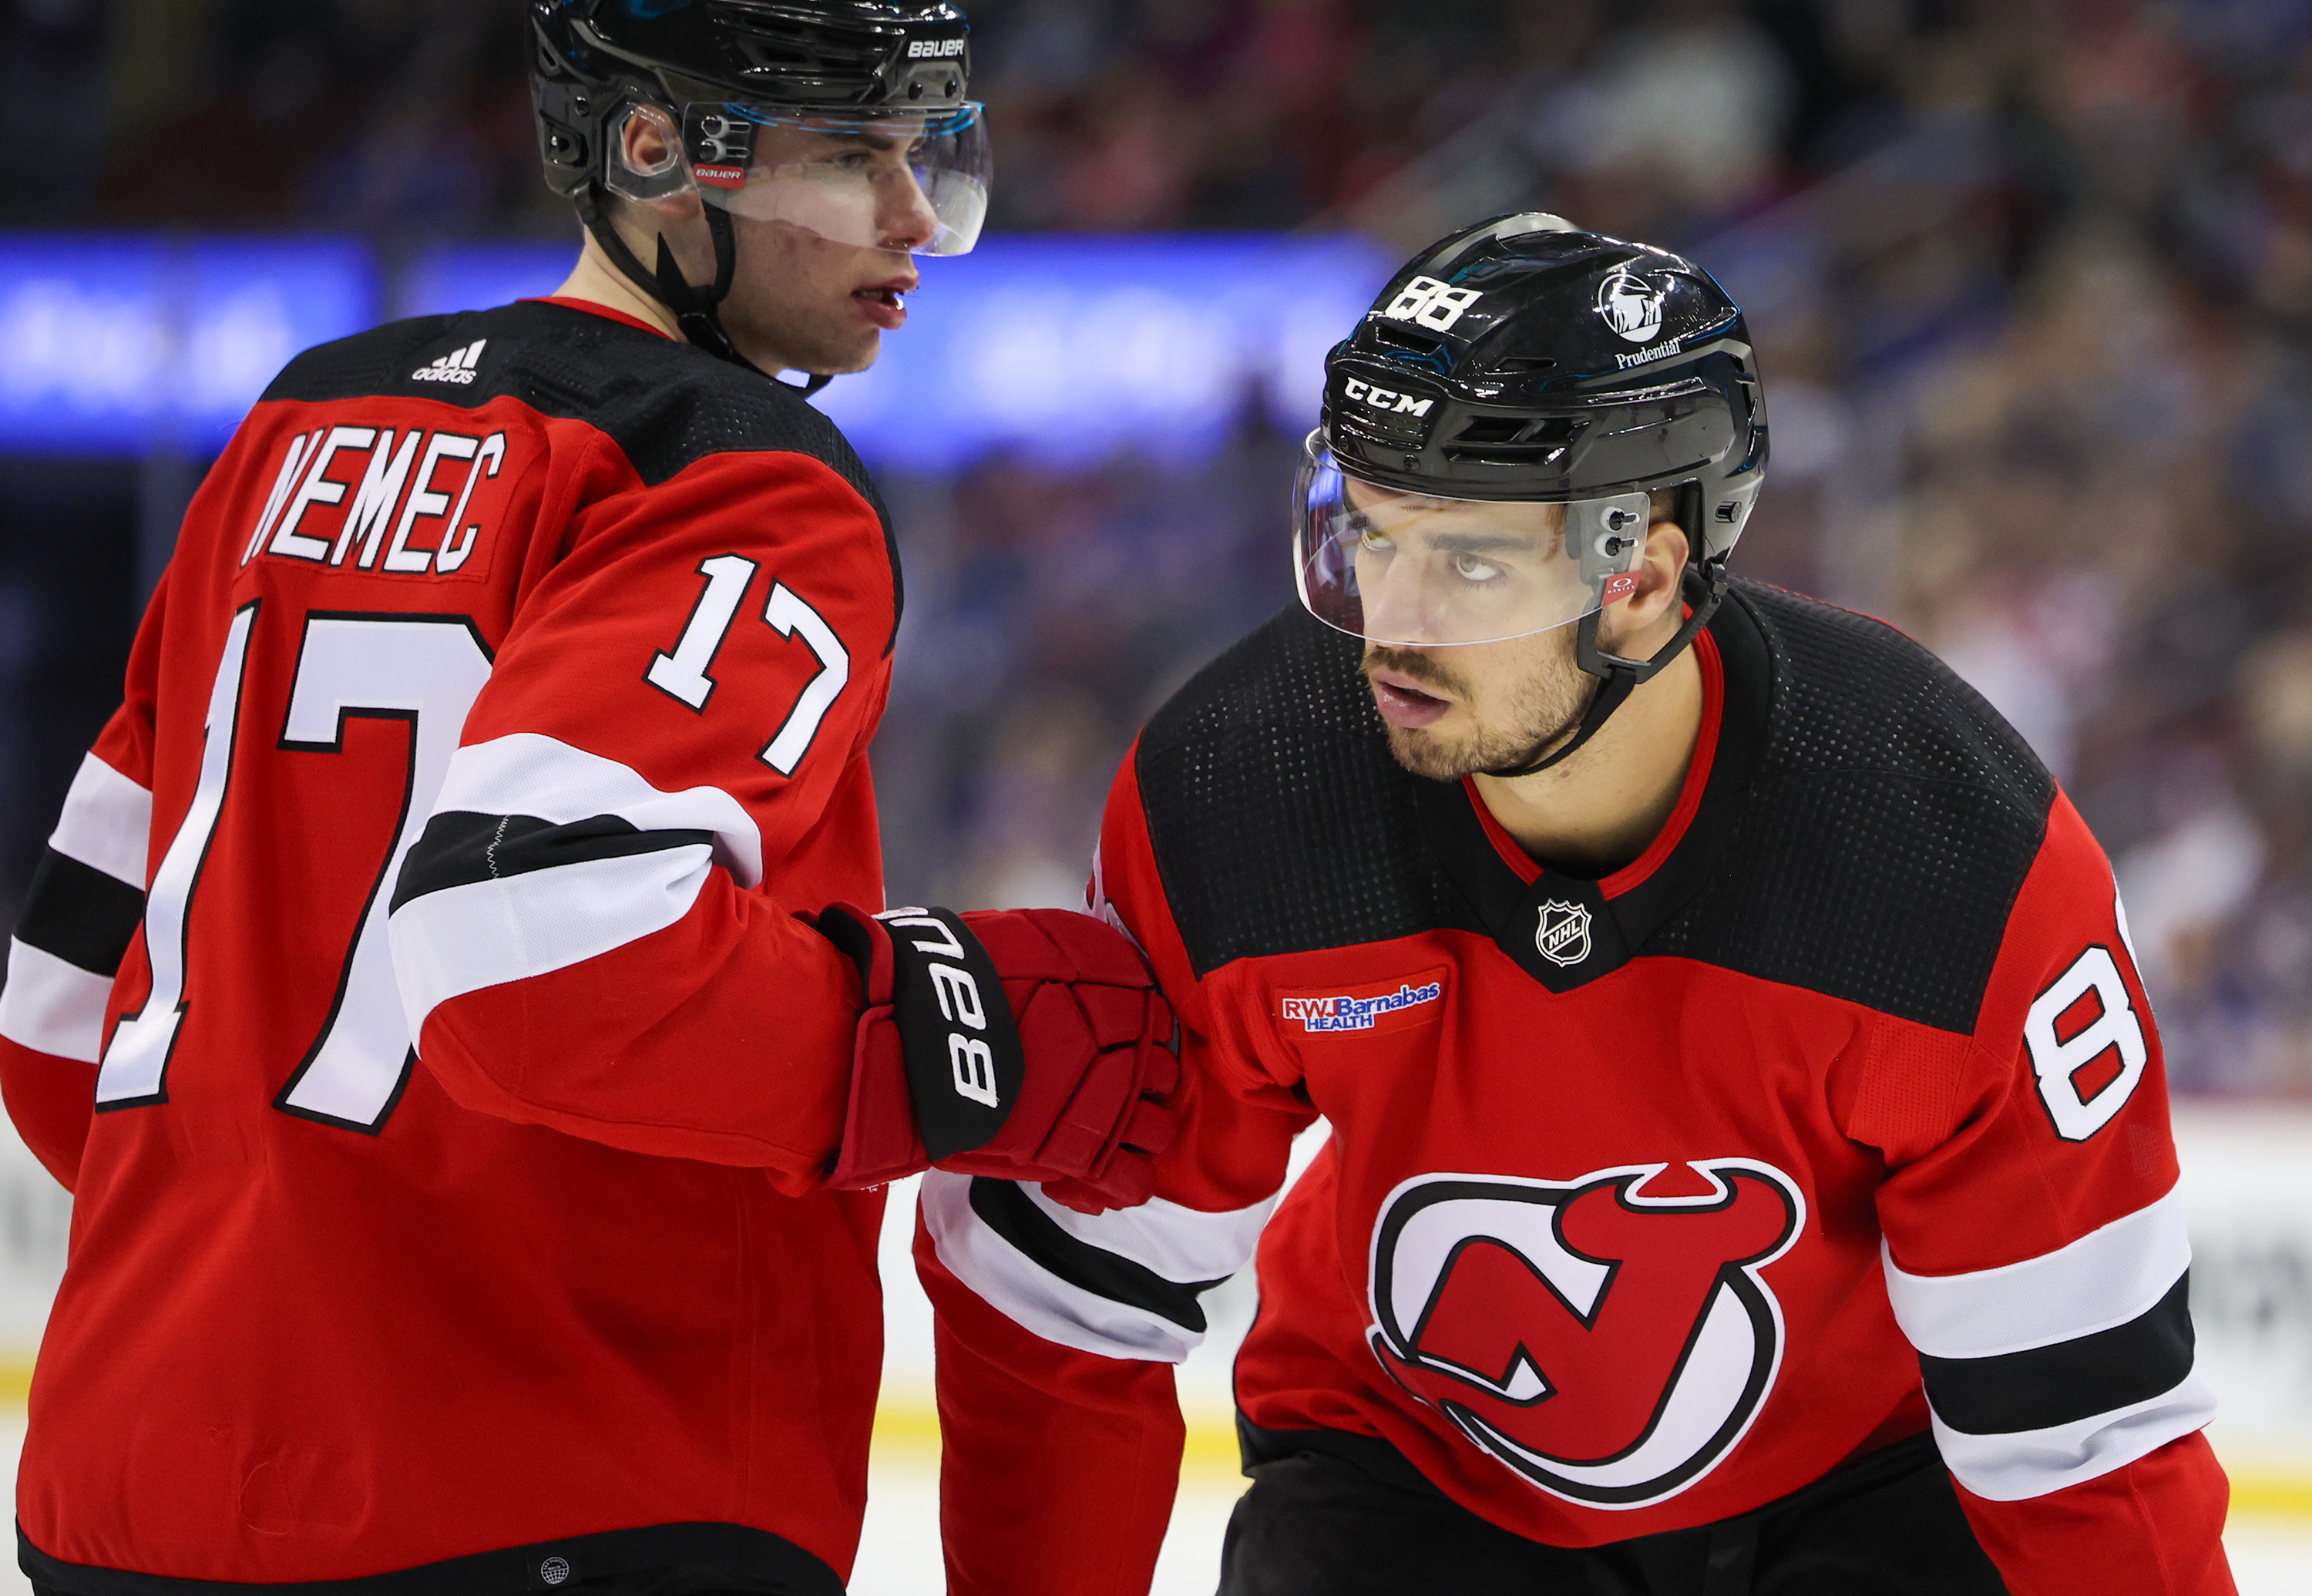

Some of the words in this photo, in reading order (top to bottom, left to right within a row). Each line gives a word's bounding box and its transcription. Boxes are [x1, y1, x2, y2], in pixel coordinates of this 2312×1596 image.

[1385, 275, 1484, 332] 88
[412, 365, 477, 384] adidas
[1615, 339, 1681, 370] Prudential
[1344, 376, 1434, 417] CCM
[240, 425, 506, 575] NEMEC
[641, 553, 849, 778] 17
[95, 598, 495, 1134] 17
[1548, 919, 1581, 949] NHL
[1307, 1013, 1373, 1030] HEALTH
[2024, 865, 2154, 1144] 8
